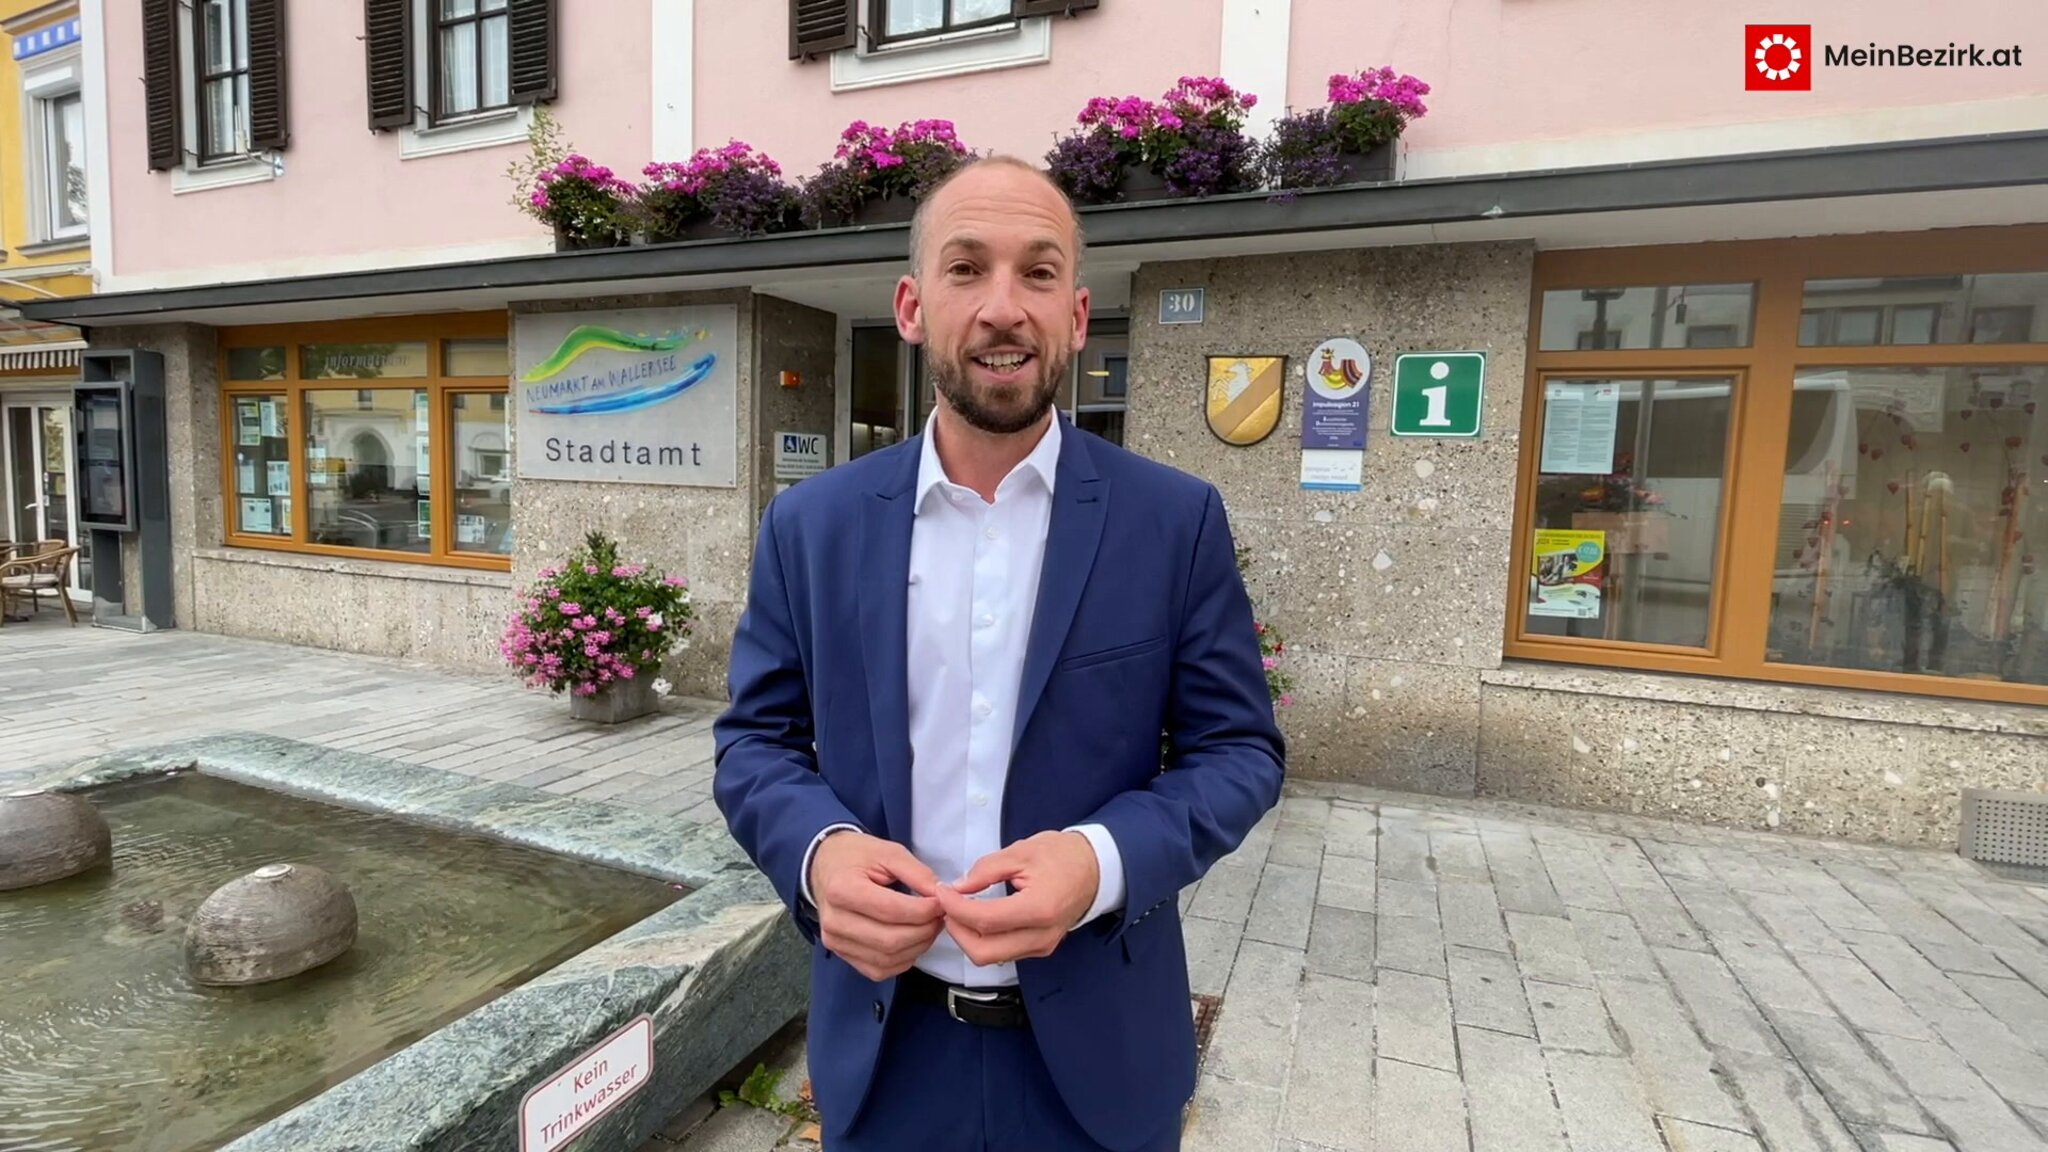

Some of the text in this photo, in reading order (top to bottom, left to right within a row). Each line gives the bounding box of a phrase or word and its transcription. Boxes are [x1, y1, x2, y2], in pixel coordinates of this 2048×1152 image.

[1169, 294, 1195, 312] 30
[526, 376, 589, 402] NEUMARKT
[608, 355, 678, 387] WALLERSEE
[545, 437, 702, 466] Stadtamt
[798, 436, 819, 455] WC
[573, 1059, 609, 1094] Kein
[540, 1064, 638, 1144] Trinkwasser
